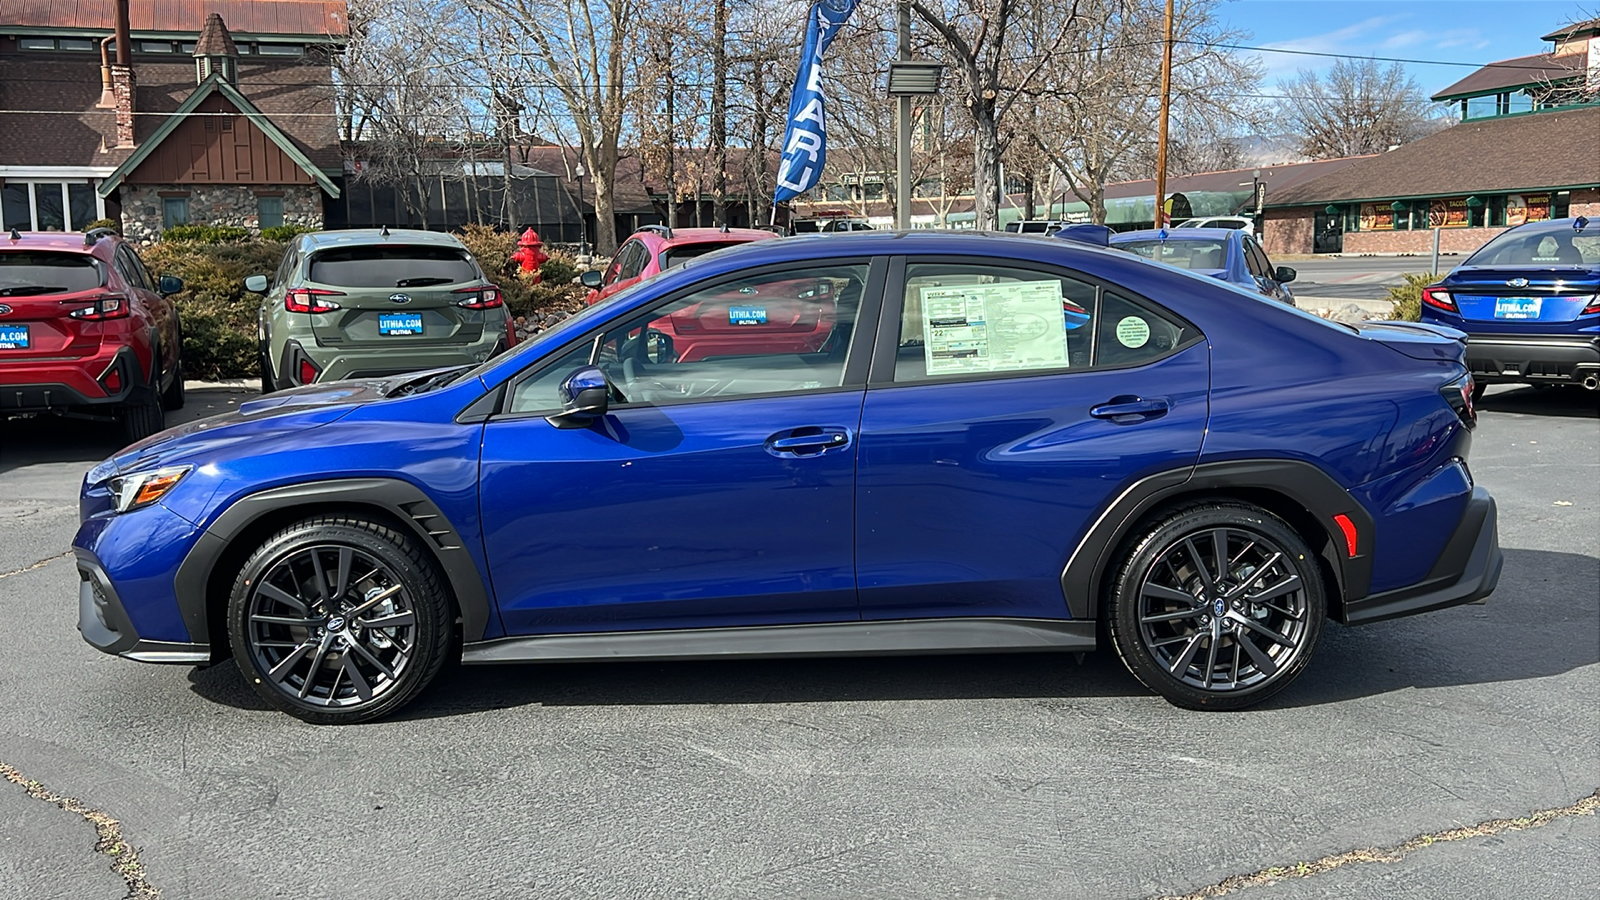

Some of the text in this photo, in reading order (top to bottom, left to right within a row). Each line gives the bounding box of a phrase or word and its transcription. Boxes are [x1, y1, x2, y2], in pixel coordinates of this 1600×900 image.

[1527, 196, 1550, 204] BURRITOS
[1375, 204, 1393, 212] TORTA
[729, 310, 767, 319] LITHIA.COM
[379, 319, 422, 329] LITHIA.COM
[934, 329, 944, 337] 22
